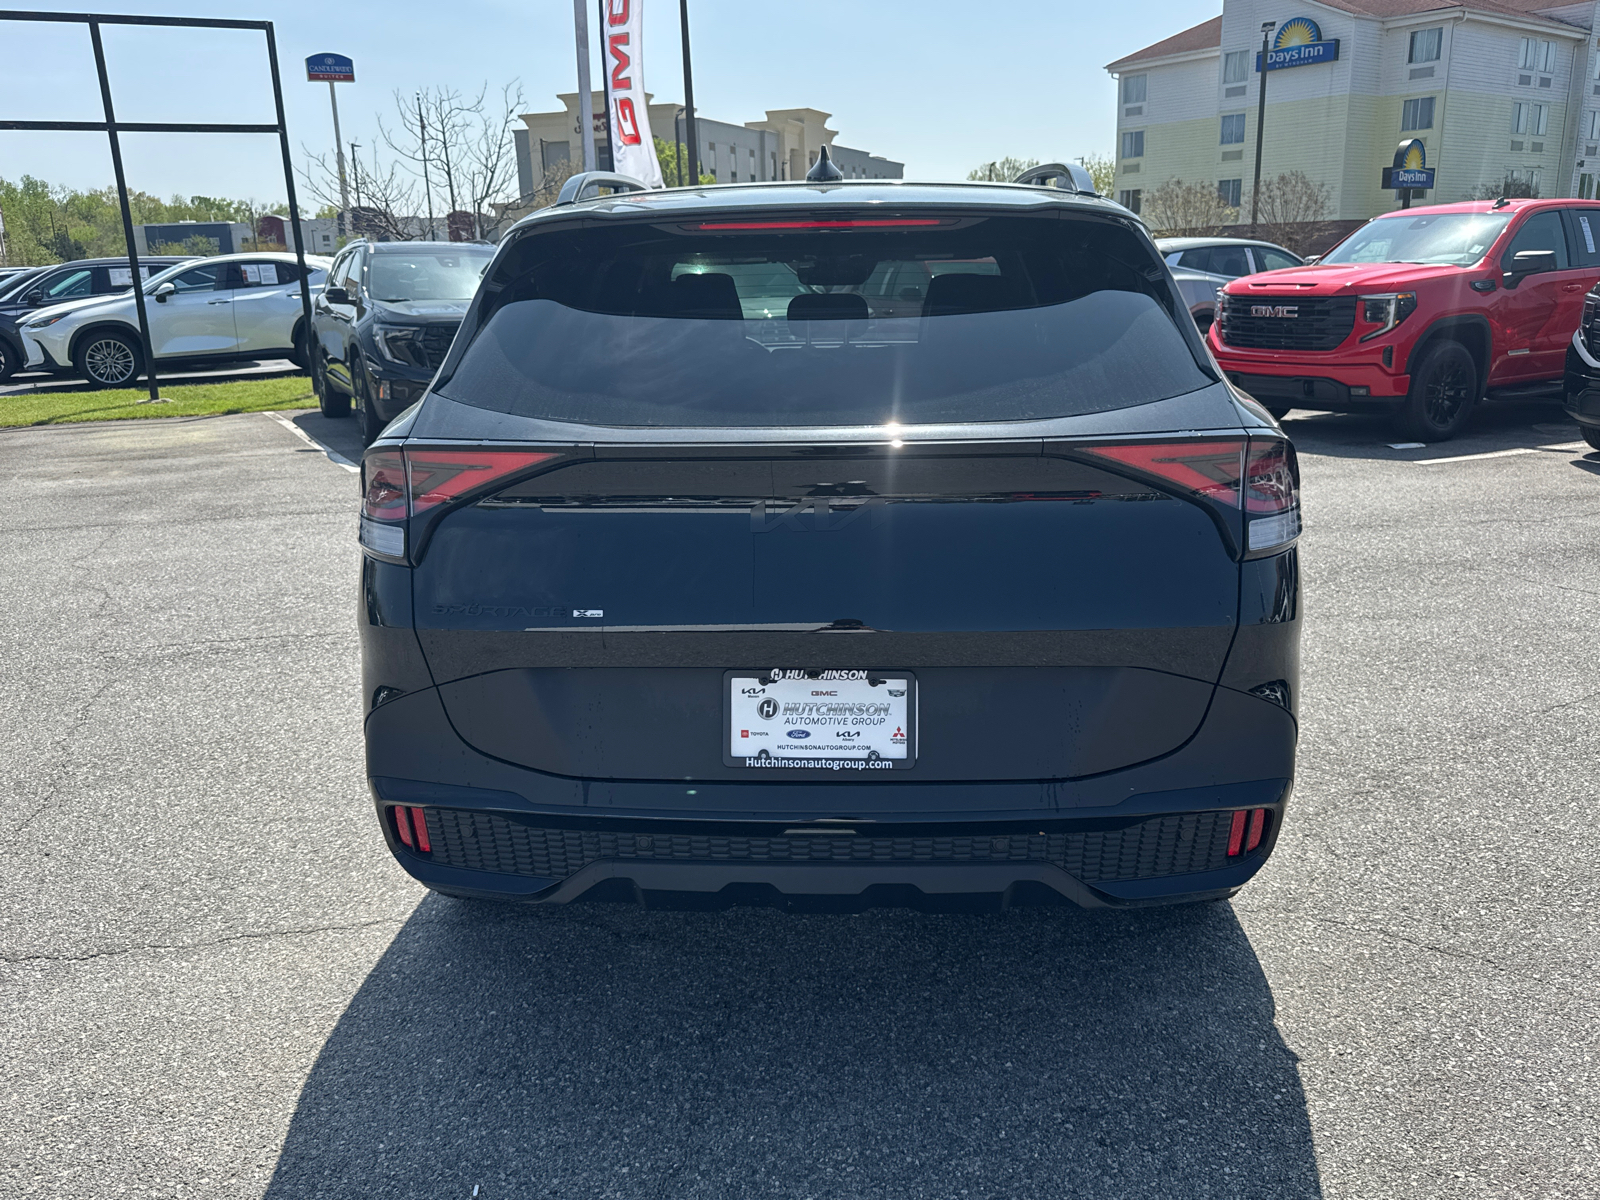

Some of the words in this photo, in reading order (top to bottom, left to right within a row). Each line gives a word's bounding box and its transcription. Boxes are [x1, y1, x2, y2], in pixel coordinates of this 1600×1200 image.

[1267, 50, 1299, 63] Days
[1301, 45, 1323, 58] Inn
[1284, 59, 1313, 67] WYNDHAM
[1399, 171, 1415, 182] Days
[1415, 172, 1427, 182] Inn
[1251, 306, 1298, 318] GMC
[431, 603, 567, 617] SPORTAGE
[785, 669, 868, 680] HUHINSON
[782, 702, 891, 717] HUTCHINSON
[784, 717, 848, 725] AUTOMOTIVE
[852, 717, 886, 726] GROUP
[746, 757, 893, 771] Hutchinsonautogroup.com
